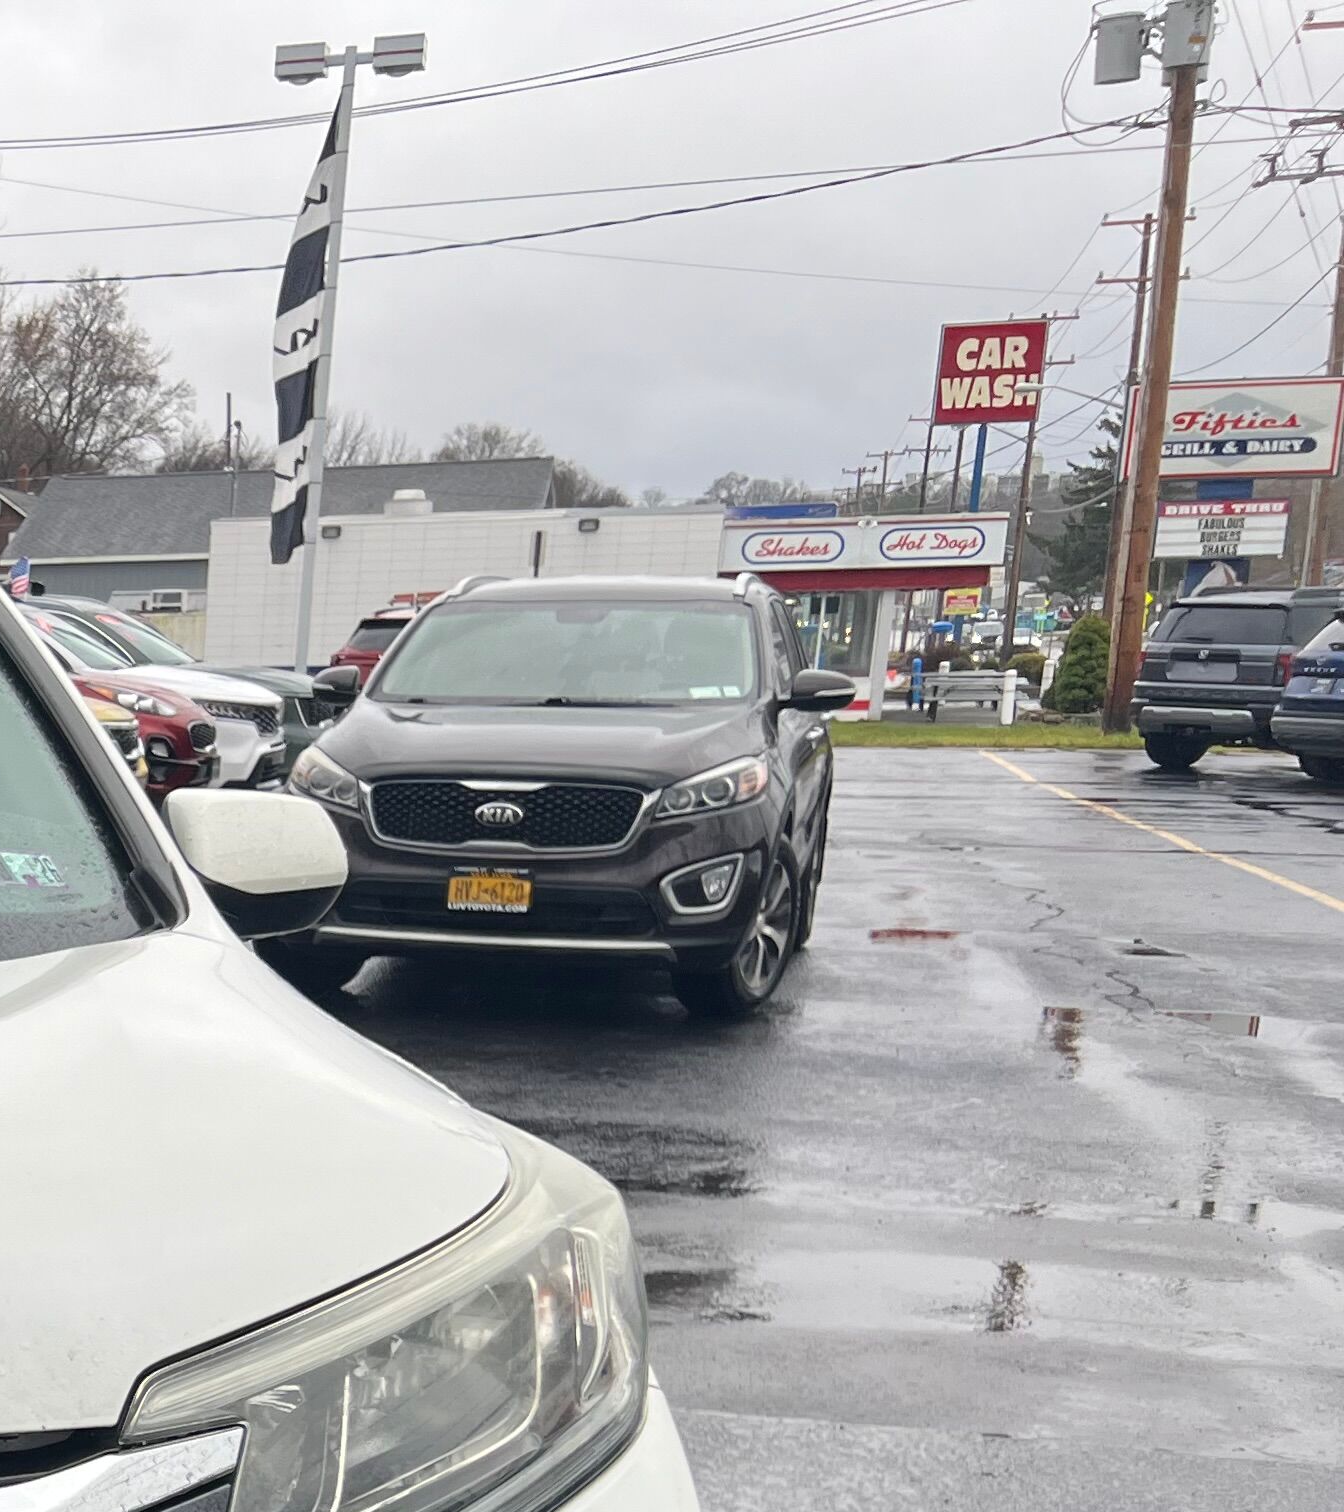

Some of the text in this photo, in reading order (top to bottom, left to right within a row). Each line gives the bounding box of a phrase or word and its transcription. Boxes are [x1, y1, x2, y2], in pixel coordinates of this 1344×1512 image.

[956, 336, 1029, 371] CAR
[940, 373, 1040, 410] WASH
[1172, 409, 1301, 436] Fifties
[1161, 439, 1305, 456] GRILL & DAIRY
[1164, 502, 1286, 516] DRIVE THRU
[1197, 517, 1246, 530] FABULOUS
[886, 532, 978, 556] Hot Dogs
[1200, 530, 1242, 543] BURGERS
[755, 538, 831, 557] Shakes
[1201, 543, 1238, 556] SHAKES
[481, 807, 515, 823] KIA
